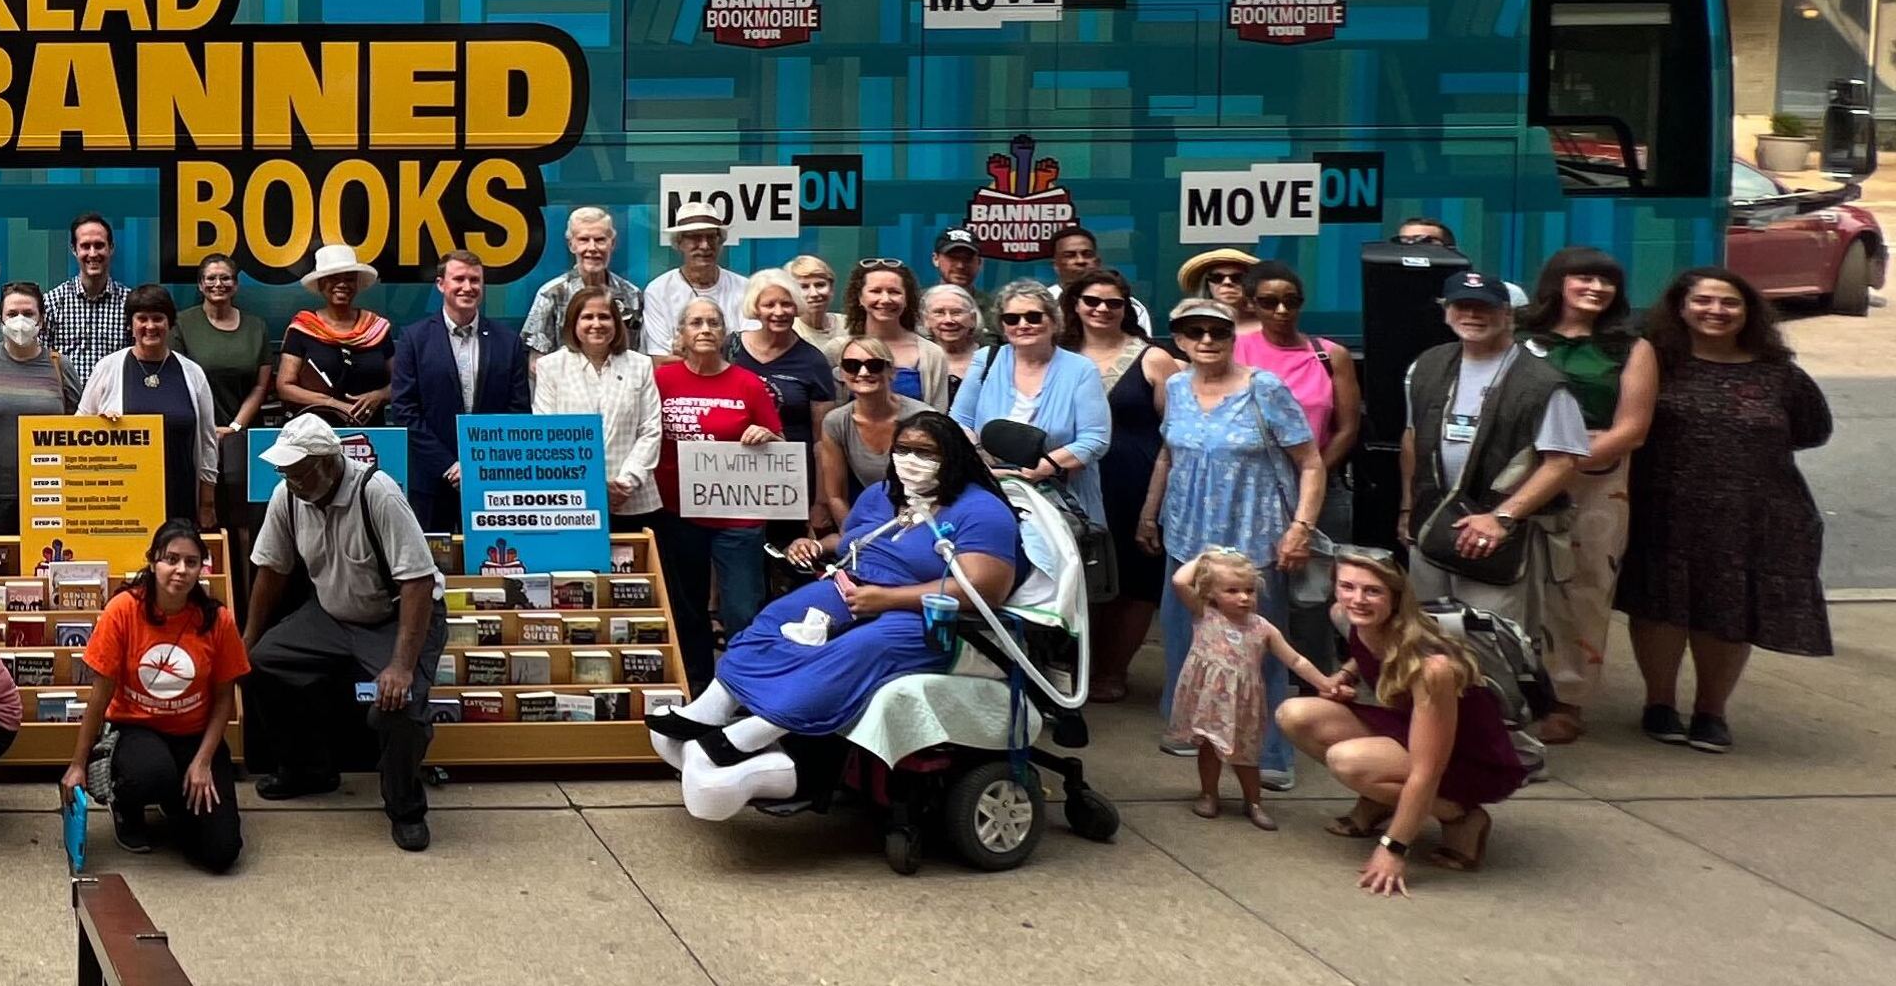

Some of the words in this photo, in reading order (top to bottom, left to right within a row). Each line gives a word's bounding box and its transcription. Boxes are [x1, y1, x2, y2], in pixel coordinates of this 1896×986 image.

[706, 9, 818, 29] BOOKMOBILE
[1230, 5, 1344, 25] BOOKMOBILE
[743, 29, 782, 40] TOUR
[1267, 25, 1306, 37] TOUR
[176, 158, 529, 268] BOOKS
[971, 204, 1072, 222] BANNED
[1002, 242, 1040, 253] TOUR
[663, 397, 745, 410] CHESTERFIELD
[662, 406, 711, 416] COUNTY
[664, 414, 698, 424] LOVES
[664, 423, 701, 433] PUBLIC
[32, 429, 150, 446] WELCOME!
[467, 427, 504, 442] Want
[507, 429, 543, 441] more
[547, 426, 594, 443] people
[471, 447, 485, 461] to
[489, 447, 522, 461] have
[526, 448, 575, 461] access
[578, 446, 593, 460] to
[694, 452, 718, 472] I'M
[724, 453, 758, 472] WITH
[765, 453, 798, 472] THE
[479, 465, 532, 481] banned
[535, 465, 587, 481] books?
[488, 494, 510, 506] Text
[513, 494, 568, 506] BOOKS
[570, 494, 582, 505] to
[693, 483, 798, 506] BANNED
[476, 515, 538, 526] 668366
[540, 515, 552, 526] to
[554, 514, 595, 526] donate!
[62, 592, 97, 600] GENDER
[62, 599, 97, 607] QUEER
[523, 624, 560, 633] GENDER
[523, 632, 560, 641] QUEER
[464, 699, 502, 707] CATCHING
